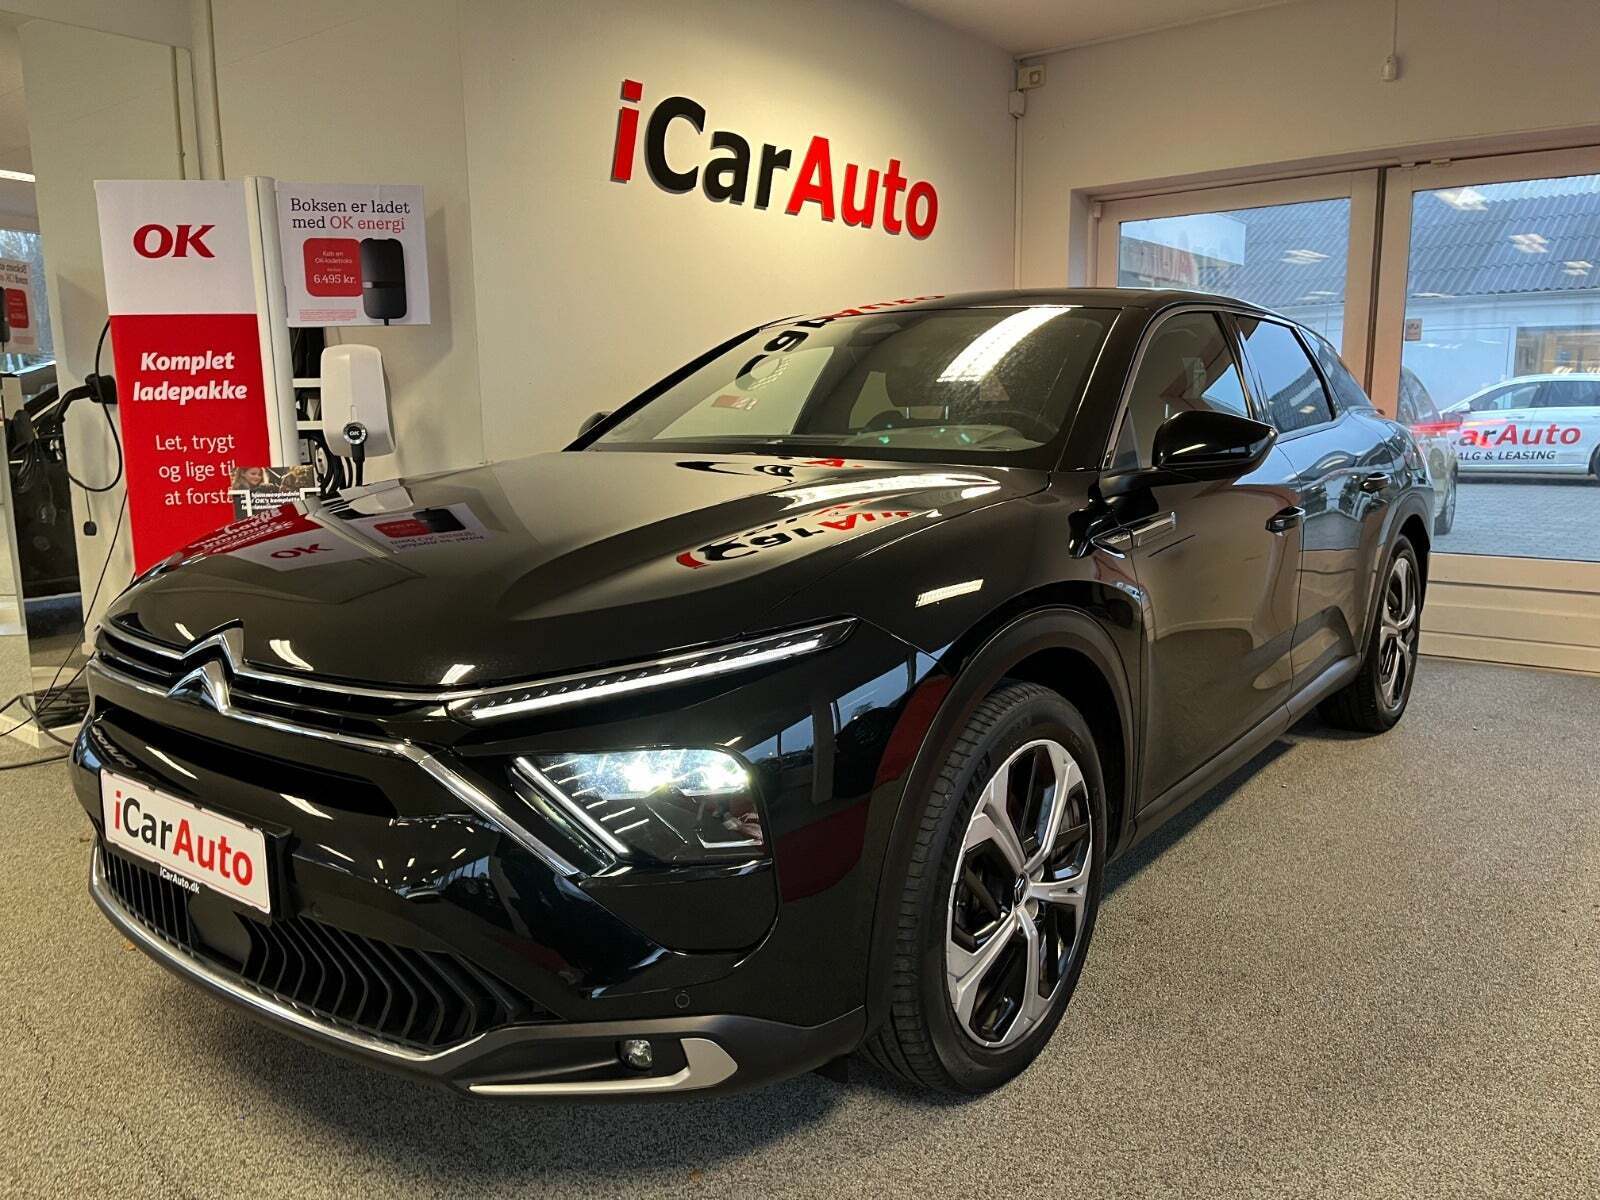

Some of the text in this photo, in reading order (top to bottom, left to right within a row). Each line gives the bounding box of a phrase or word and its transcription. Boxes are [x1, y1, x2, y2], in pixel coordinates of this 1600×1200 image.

[610, 79, 938, 241] iCarAuto
[290, 198, 411, 214] Boksen er ladet
[292, 215, 405, 234] med OK energi
[133, 223, 216, 259] OK
[140, 350, 235, 376] Komplet
[132, 380, 248, 406] ladepakke
[155, 434, 235, 454] Let, trygt
[1453, 423, 1581, 446] arAuto
[1458, 450, 1556, 461] ALG & LEASING
[159, 465, 181, 483] og
[185, 461, 215, 481] lige
[165, 490, 182, 506] at
[113, 790, 253, 886] iCarAuto
[160, 867, 200, 894] iCarAuto.dk
